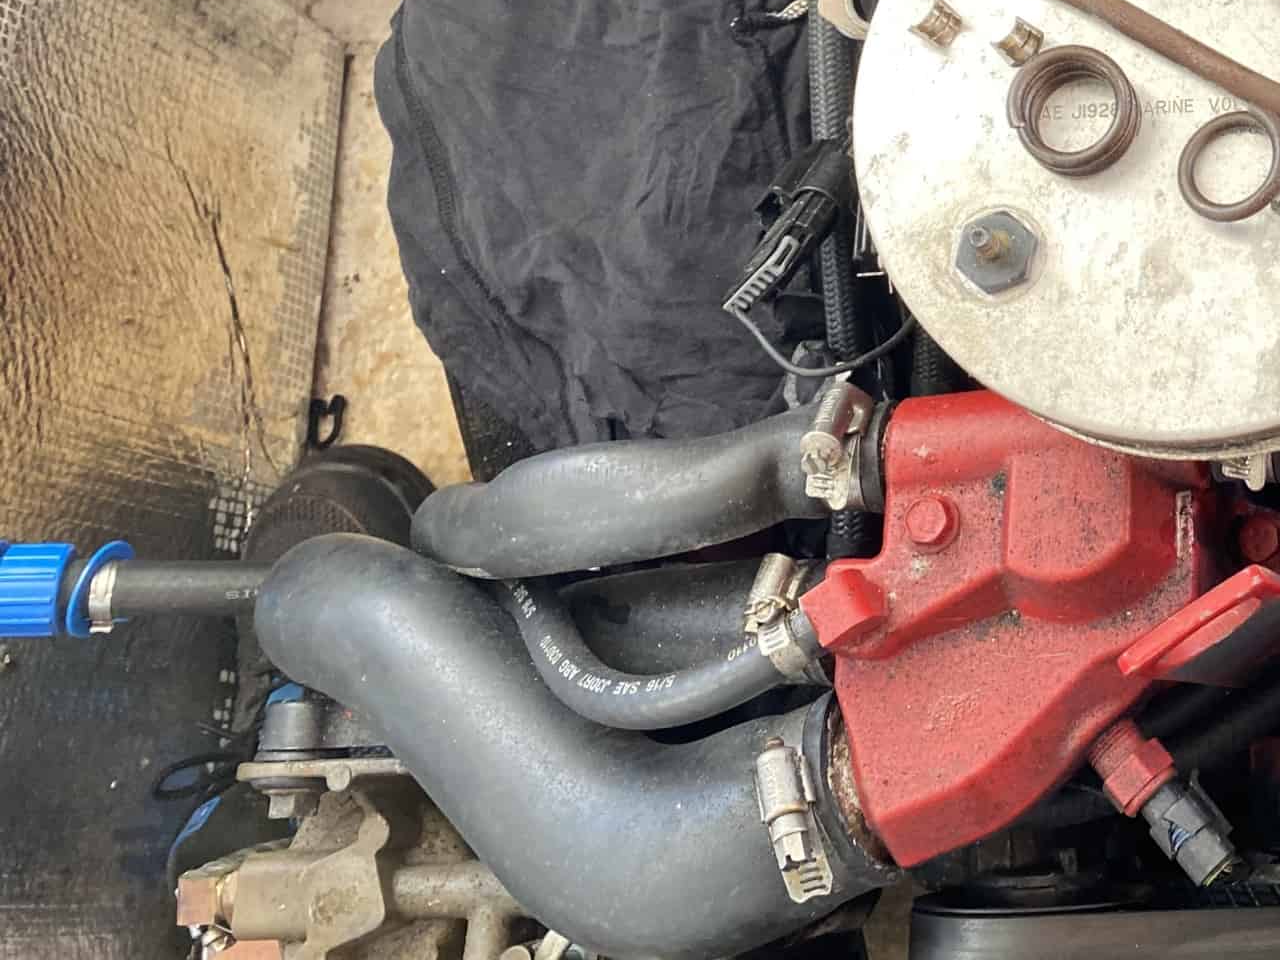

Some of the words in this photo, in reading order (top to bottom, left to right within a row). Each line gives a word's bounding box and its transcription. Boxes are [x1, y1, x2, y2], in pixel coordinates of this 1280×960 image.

[1144, 98, 1195, 115] ARINE
[612, 680, 640, 696] SAE
[645, 674, 676, 692] 5/16
